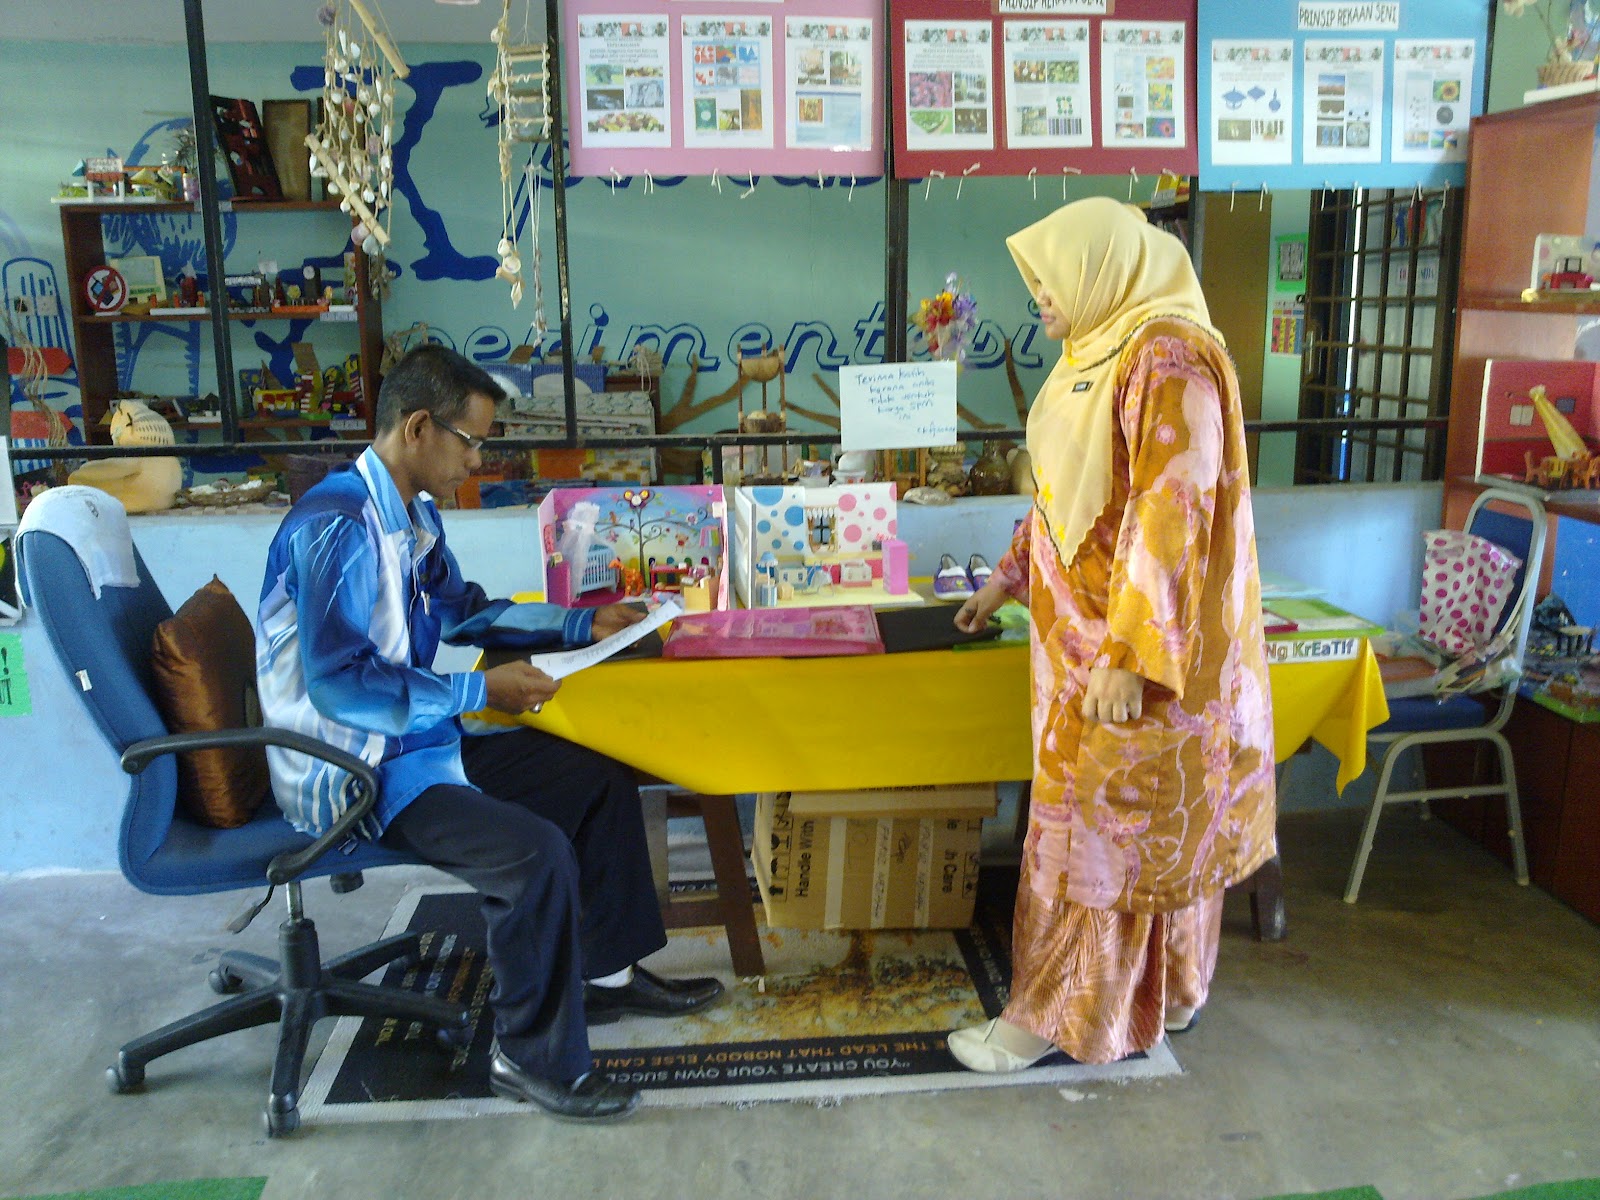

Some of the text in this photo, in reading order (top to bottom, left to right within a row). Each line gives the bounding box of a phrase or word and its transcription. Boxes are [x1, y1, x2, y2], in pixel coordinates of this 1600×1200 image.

[1299, 2, 1397, 27] PRINSIP REKAAN SENI
[795, 852, 812, 897] Handle
[704, 1049, 782, 1064] NOBODY
[787, 1047, 835, 1059] THAT
[839, 1043, 889, 1056] LEAD
[606, 1056, 646, 1069] CAN
[651, 1053, 698, 1067] ELSE
[782, 1060, 858, 1074] CREATE
[674, 1067, 720, 1081] OWN
[726, 1064, 778, 1078] YOUR
